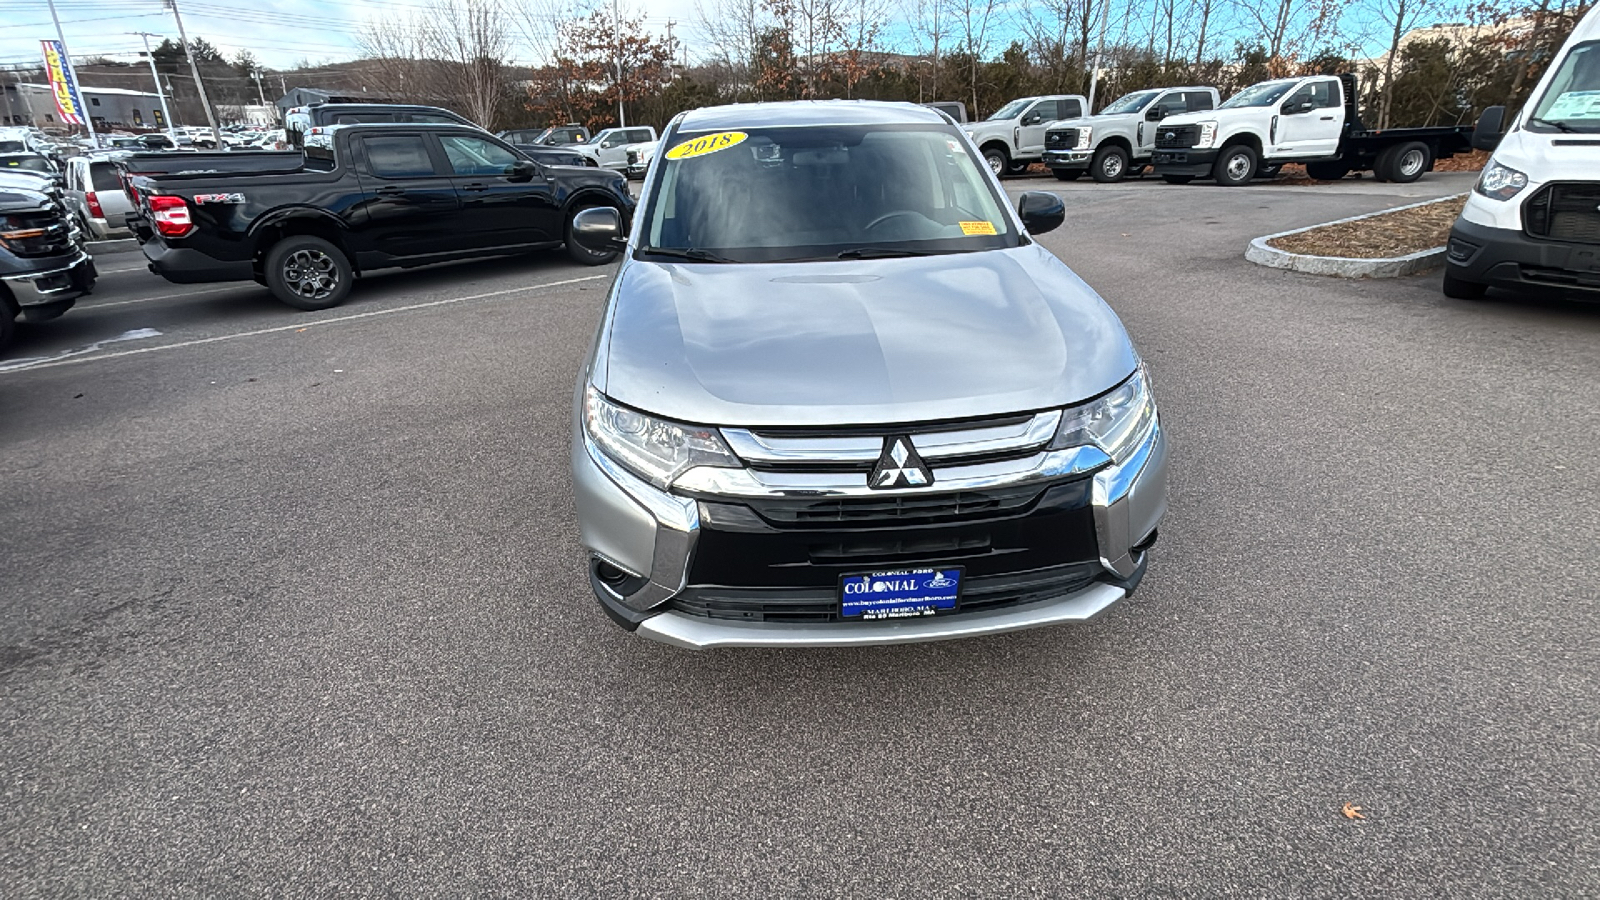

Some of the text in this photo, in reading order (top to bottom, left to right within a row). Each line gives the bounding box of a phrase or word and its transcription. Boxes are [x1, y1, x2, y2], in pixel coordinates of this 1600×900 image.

[680, 133, 733, 157] 2018
[193, 193, 246, 205] FX4
[844, 579, 919, 594] COLONIAL
[842, 595, 957, 607] www.buycolonialfordmarlboro.com
